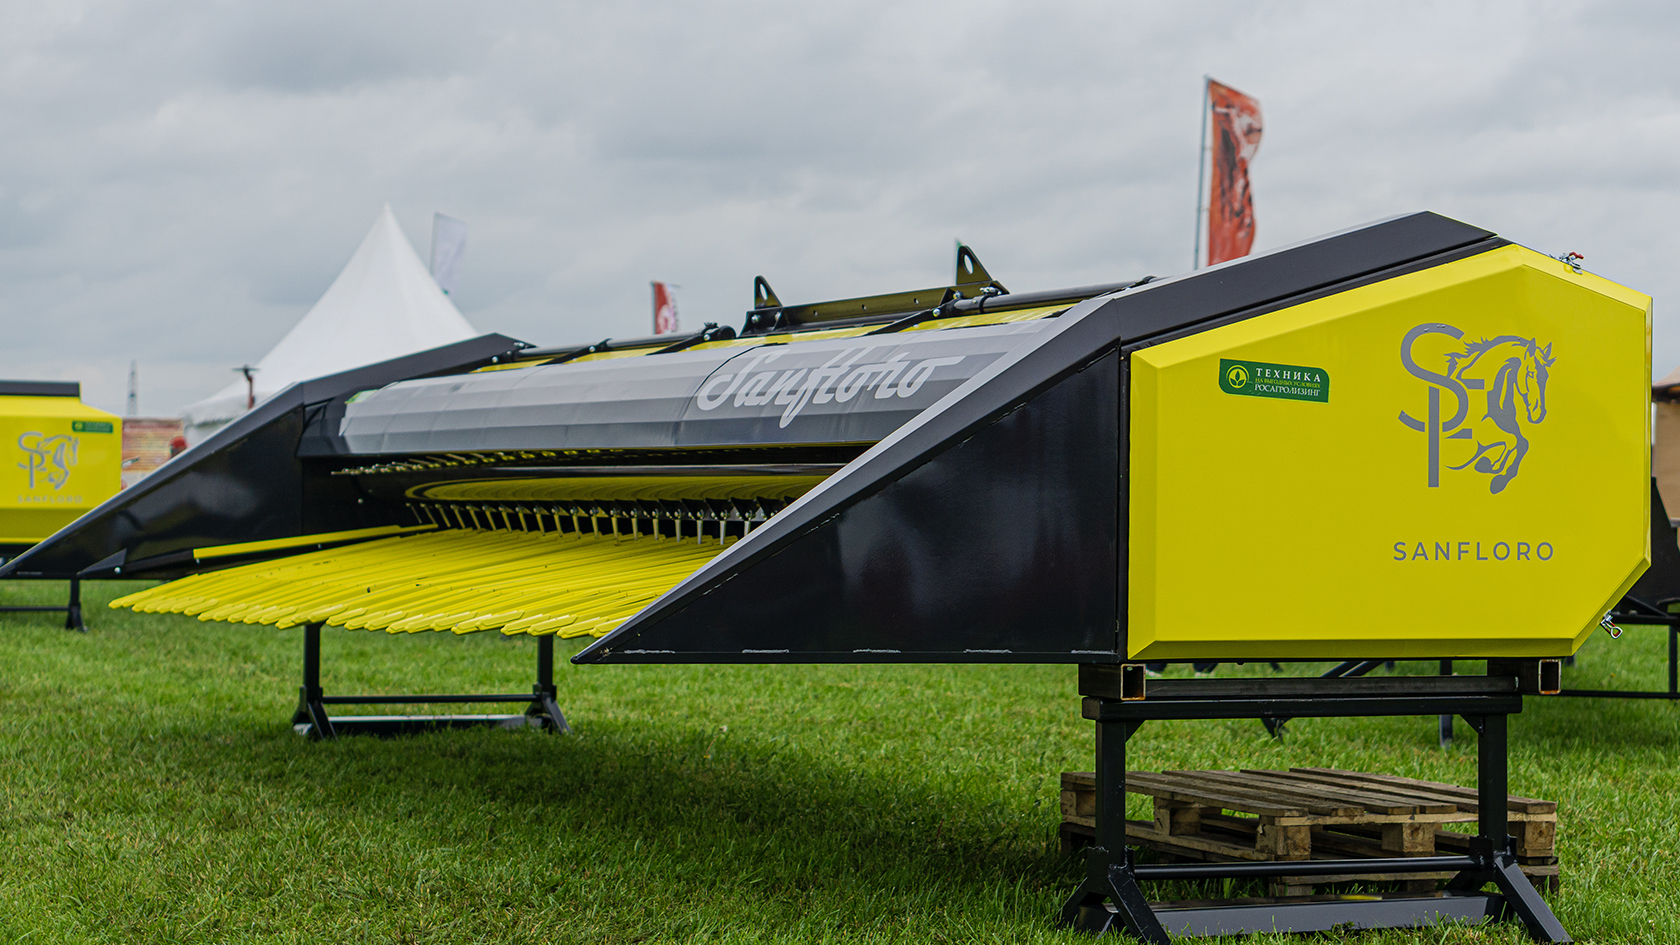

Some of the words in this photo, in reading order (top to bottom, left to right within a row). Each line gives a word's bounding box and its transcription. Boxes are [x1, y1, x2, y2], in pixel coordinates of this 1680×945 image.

[1256, 368, 1321, 382] ТЕХНИКА
[697, 346, 966, 428] Sanfloro
[1264, 378, 1292, 386] ВЫГОДНЫХ
[1254, 384, 1321, 396] РОСАГРОЛИЗИНГ
[17, 495, 83, 504] SANFLORO
[1393, 541, 1554, 561] SANFLORO
